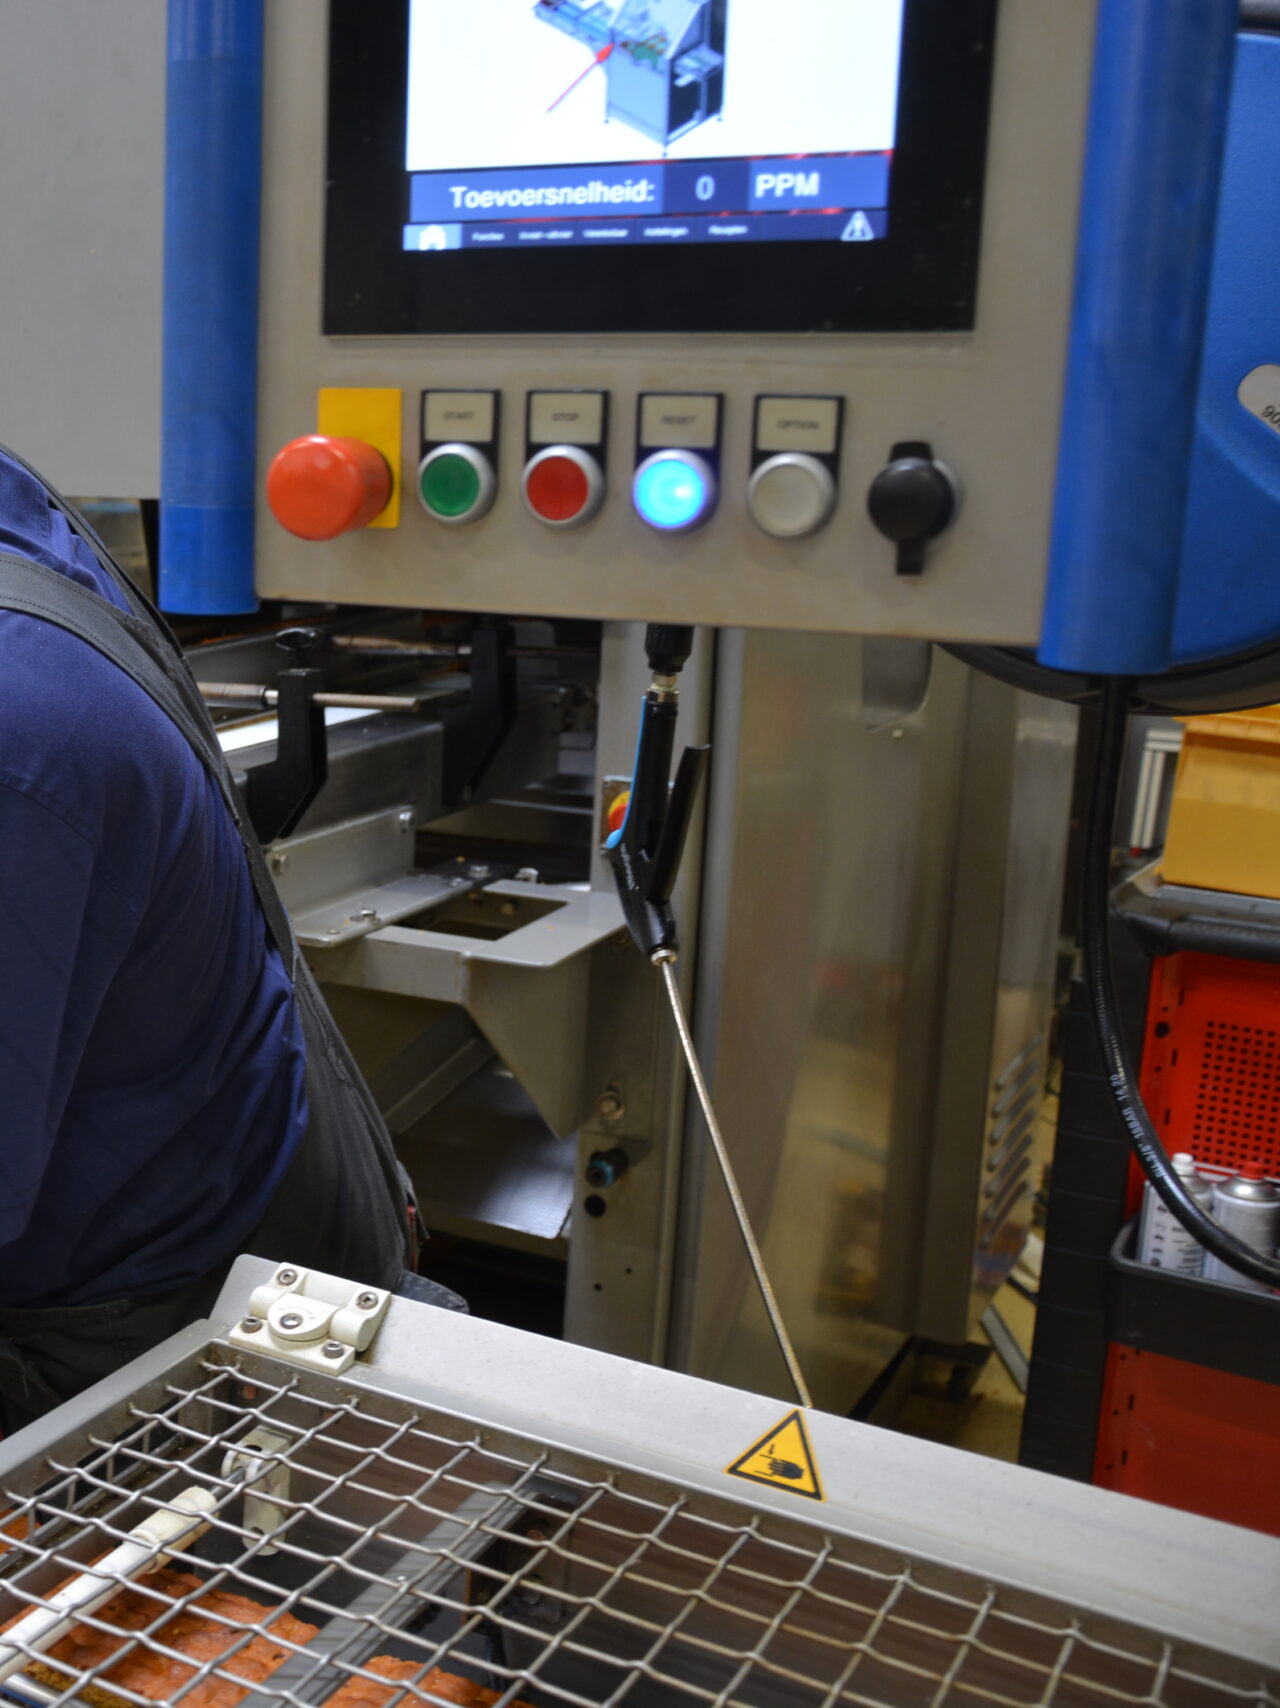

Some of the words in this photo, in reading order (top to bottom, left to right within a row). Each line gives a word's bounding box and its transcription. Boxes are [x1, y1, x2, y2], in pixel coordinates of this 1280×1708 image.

[448, 178, 656, 209] Toevoersnelheid:
[695, 174, 716, 201] 0
[754, 172, 821, 199] PPM
[442, 411, 475, 421] START
[552, 412, 580, 422] STOP
[660, 415, 697, 426] RESET
[775, 419, 821, 431] OPTION
